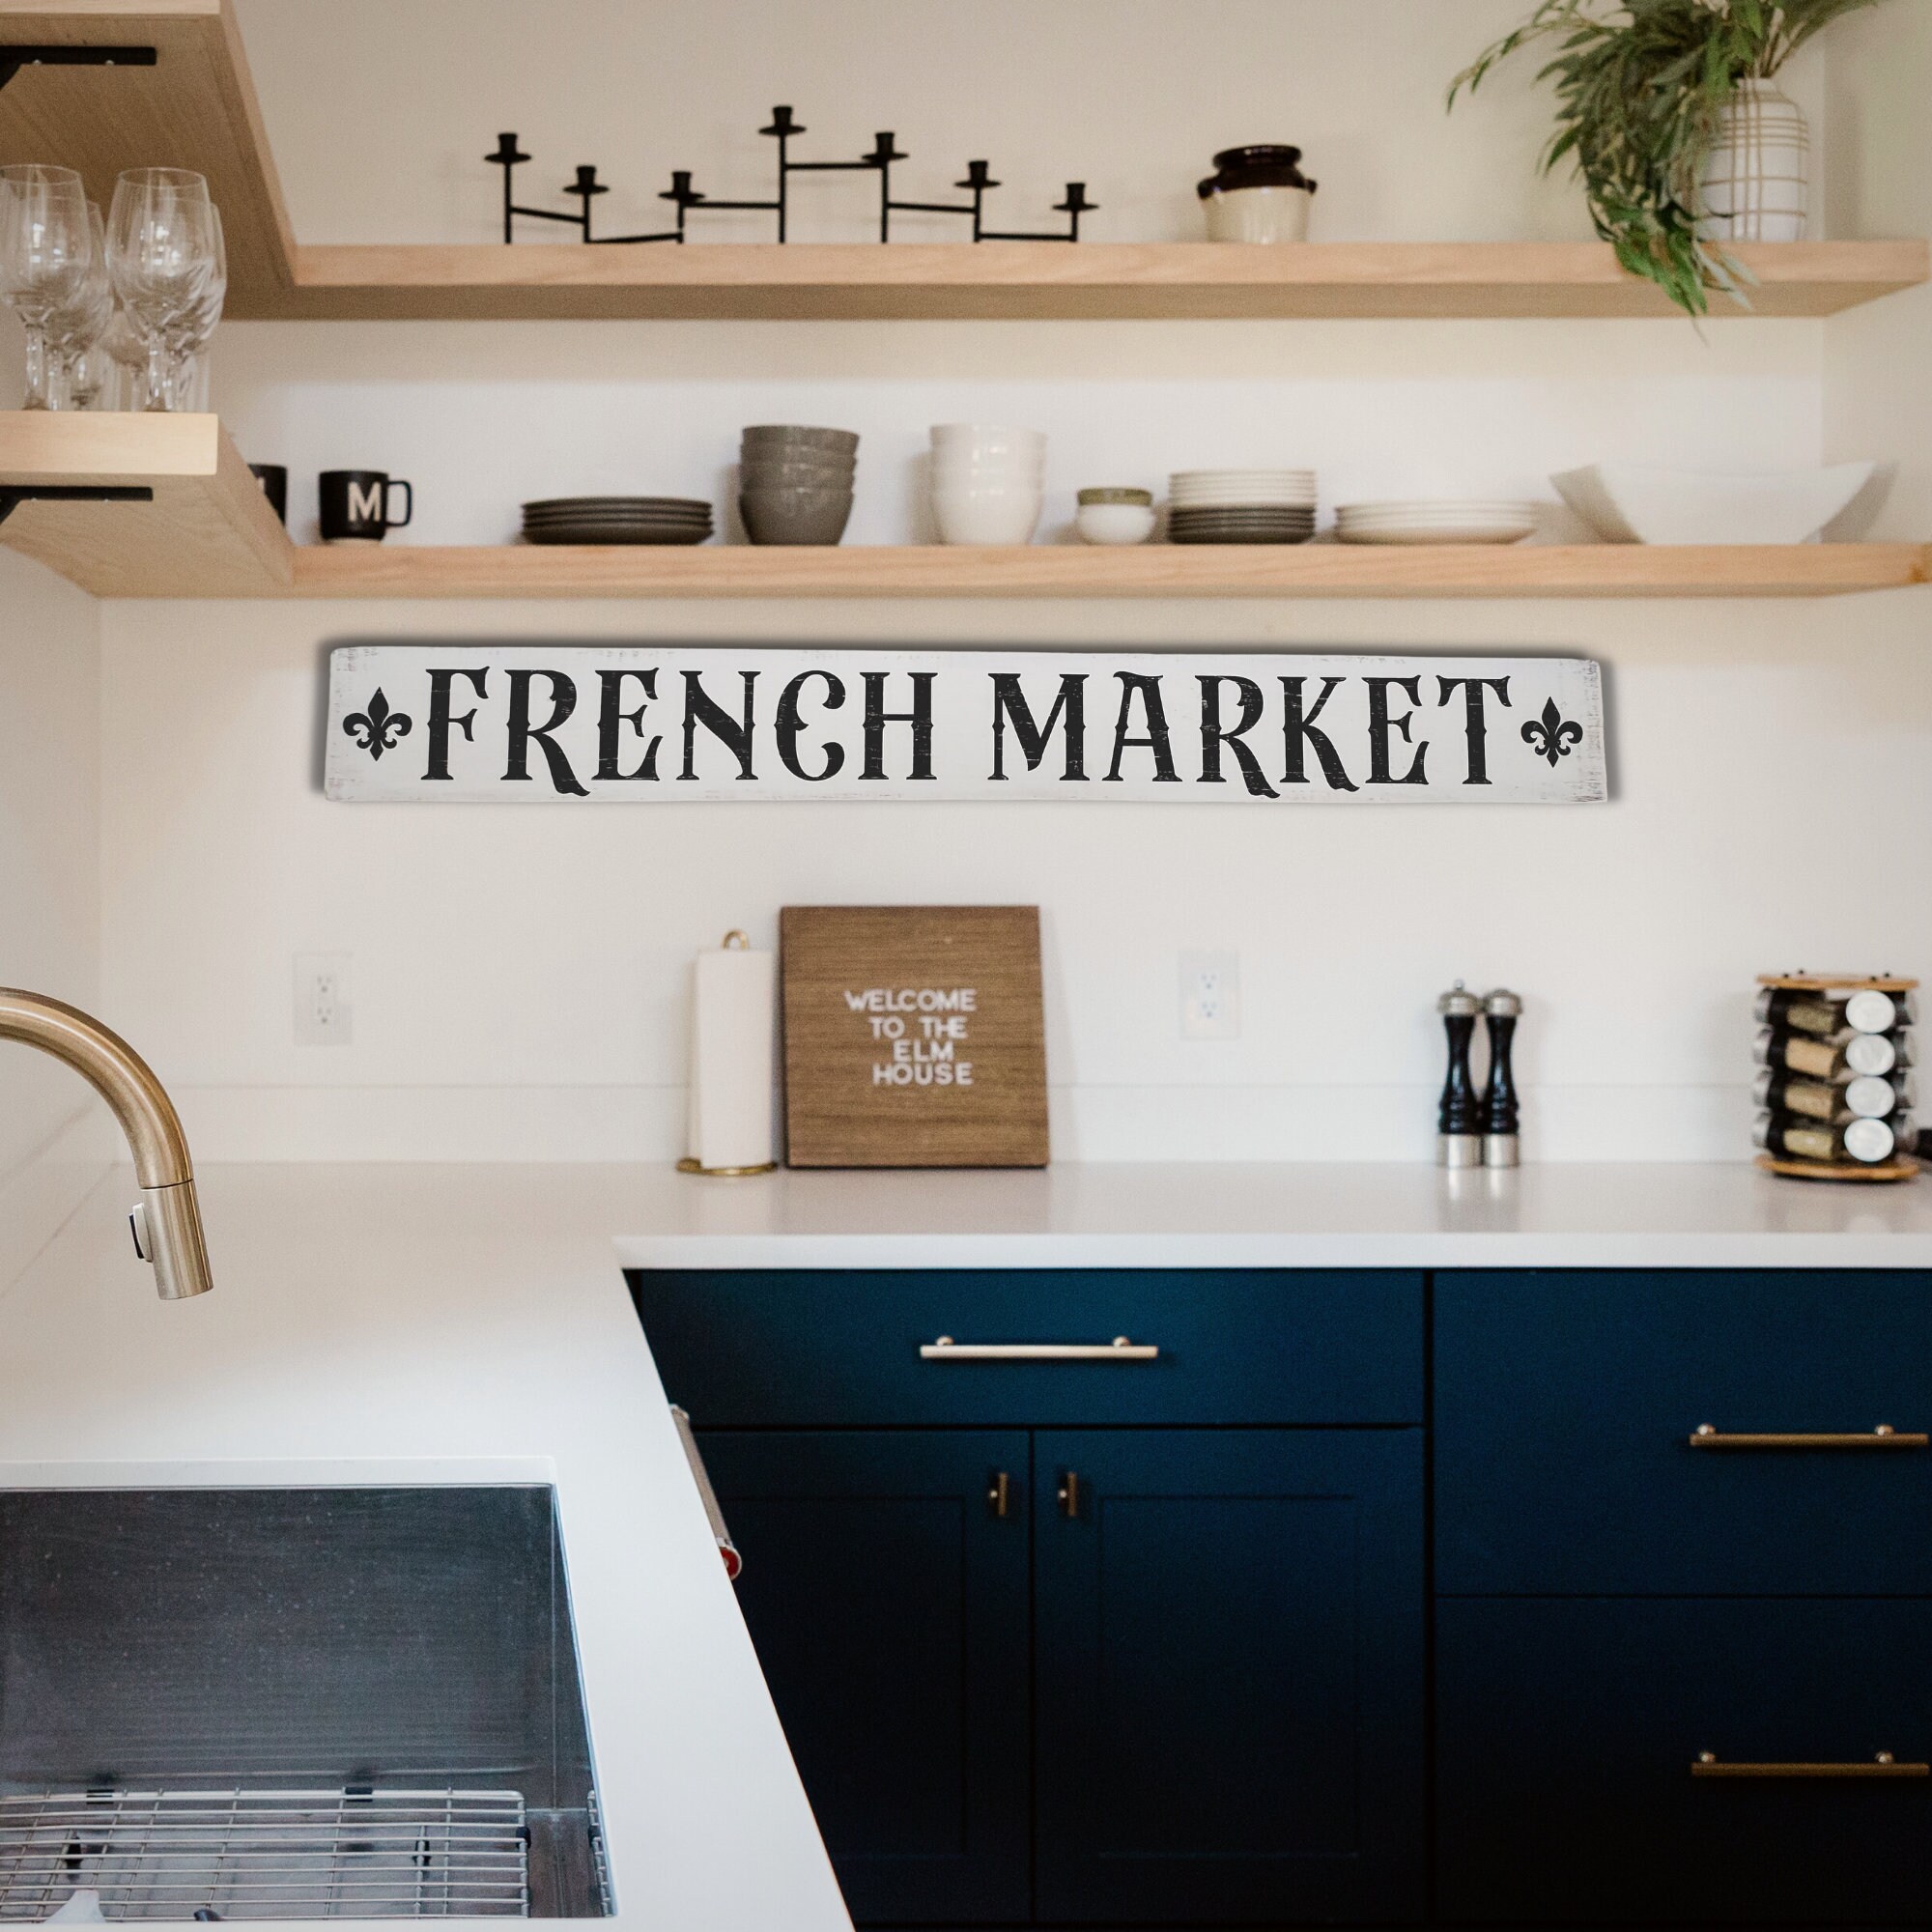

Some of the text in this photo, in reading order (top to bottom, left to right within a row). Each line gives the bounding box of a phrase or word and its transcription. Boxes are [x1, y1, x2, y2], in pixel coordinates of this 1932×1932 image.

[347, 480, 382, 523] M
[420, 666, 1513, 799] FRENCH MARKET
[843, 988, 978, 1012] WELCOME
[868, 1016, 968, 1039] TO THE
[893, 1038, 954, 1063] ELM
[872, 1062, 974, 1086] HOUSE
